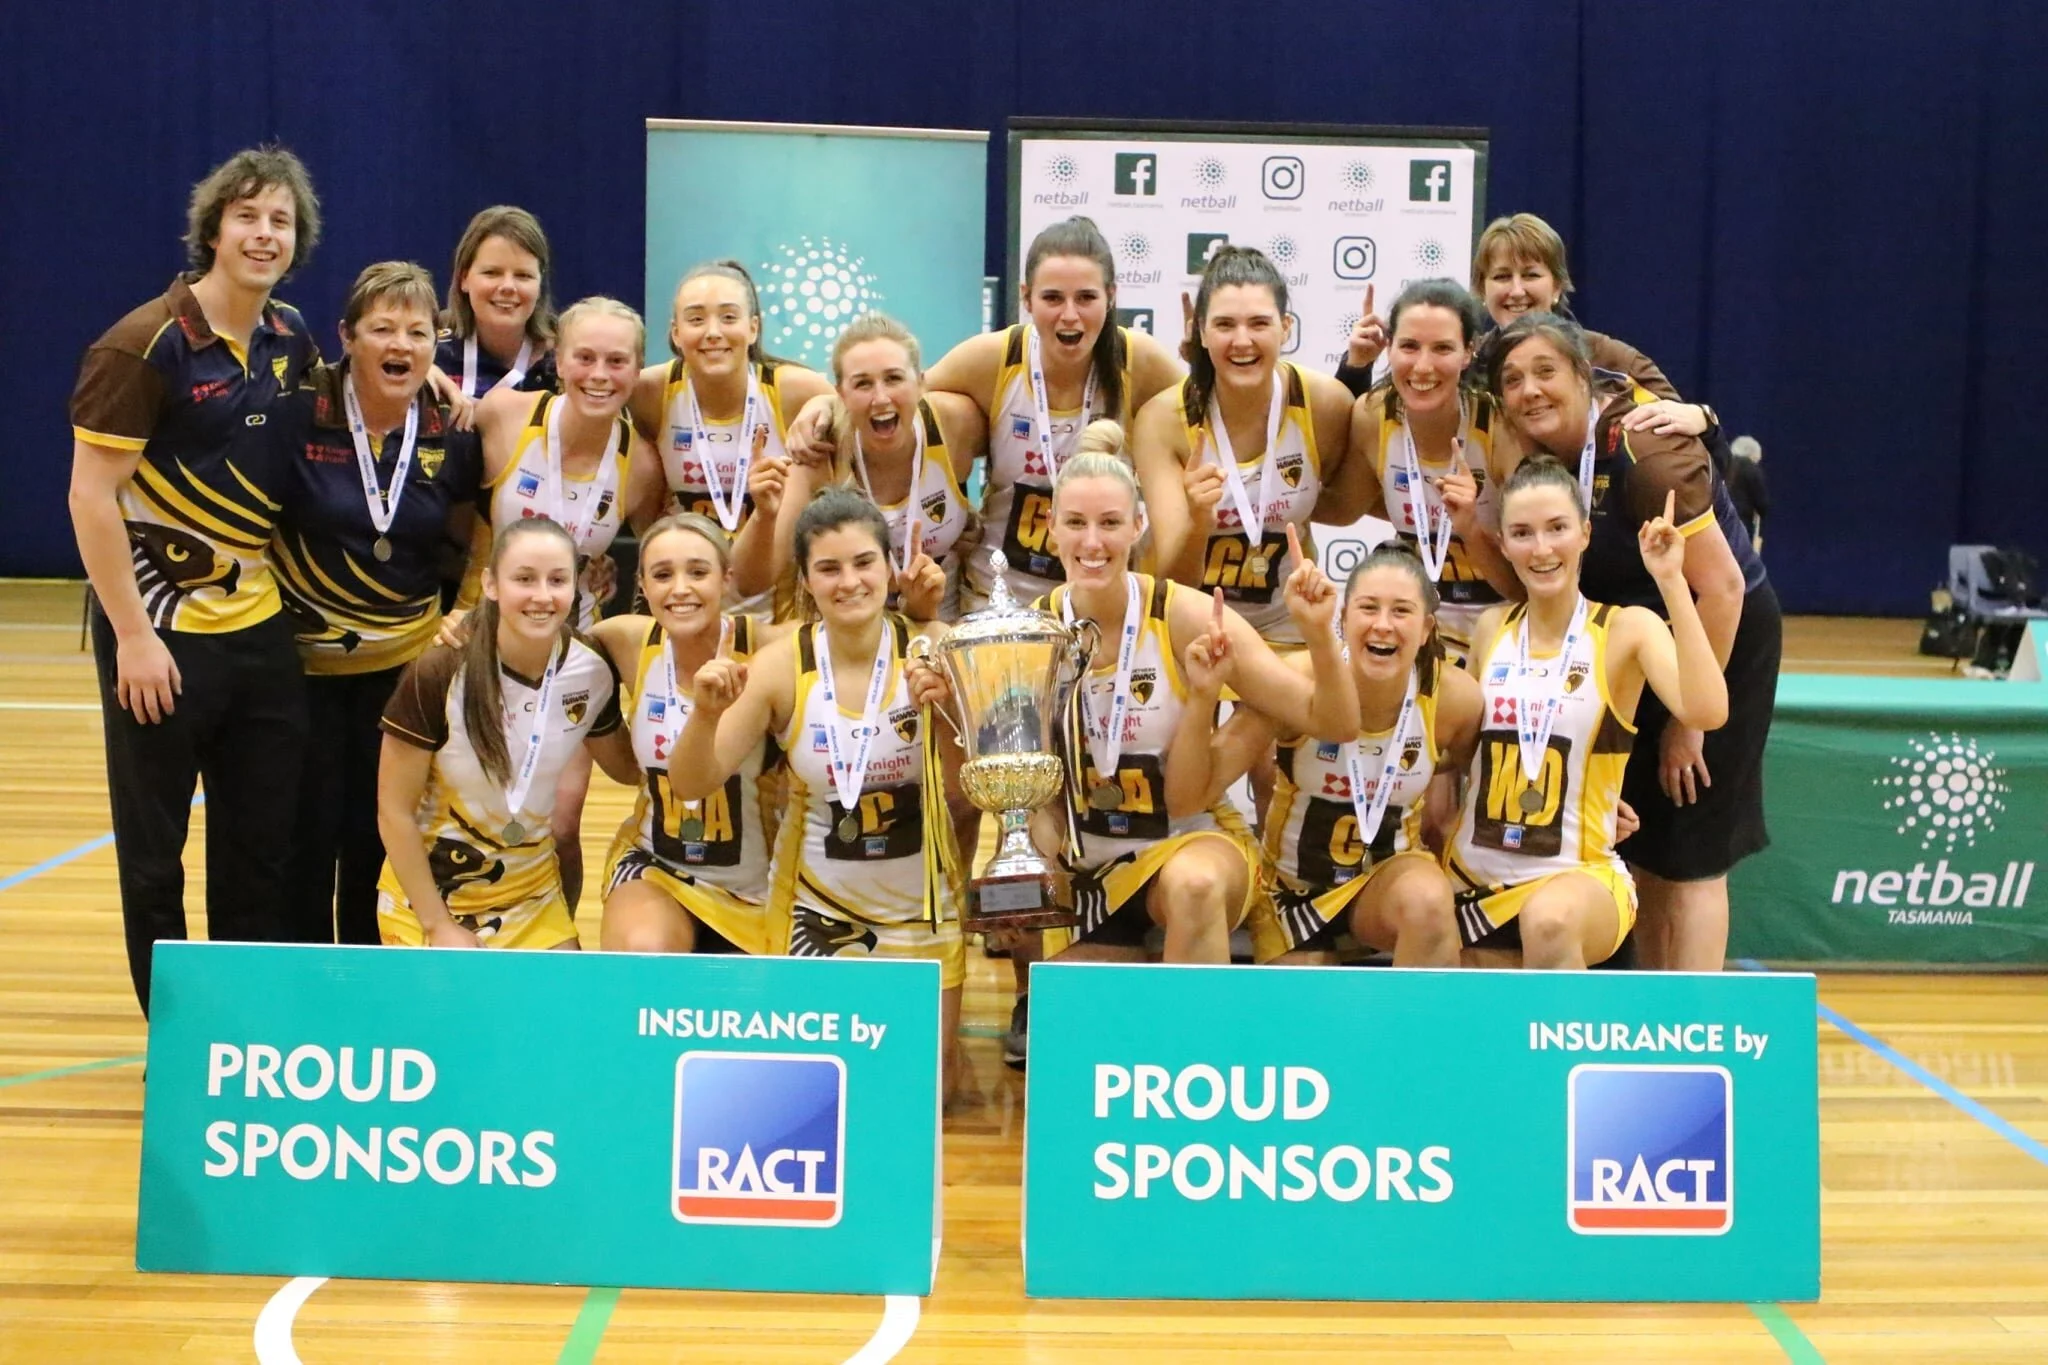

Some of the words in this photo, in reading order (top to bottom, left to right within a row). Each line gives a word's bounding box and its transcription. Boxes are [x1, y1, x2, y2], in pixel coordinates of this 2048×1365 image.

[1033, 191, 1089, 205] netball
[1180, 195, 1236, 209] netball
[1328, 199, 1384, 212] netball
[1115, 270, 1161, 284] etball
[889, 709, 918, 725] HAWKS
[1486, 742, 1563, 827] WD
[1831, 860, 2035, 908] netball
[1887, 909, 1973, 925] TASMANIA
[637, 1007, 841, 1043] INSURANCE
[851, 1013, 886, 1050] by
[1528, 1021, 1724, 1053] INSURANCE
[1735, 1025, 1768, 1060] by
[206, 1042, 436, 1103] PROUD
[1093, 1063, 1330, 1122] PROUD
[203, 1121, 558, 1189] SPONSORS
[697, 1143, 826, 1195] RACT
[1093, 1141, 1454, 1203] SPONSORS
[1592, 1155, 1717, 1205] RACT
